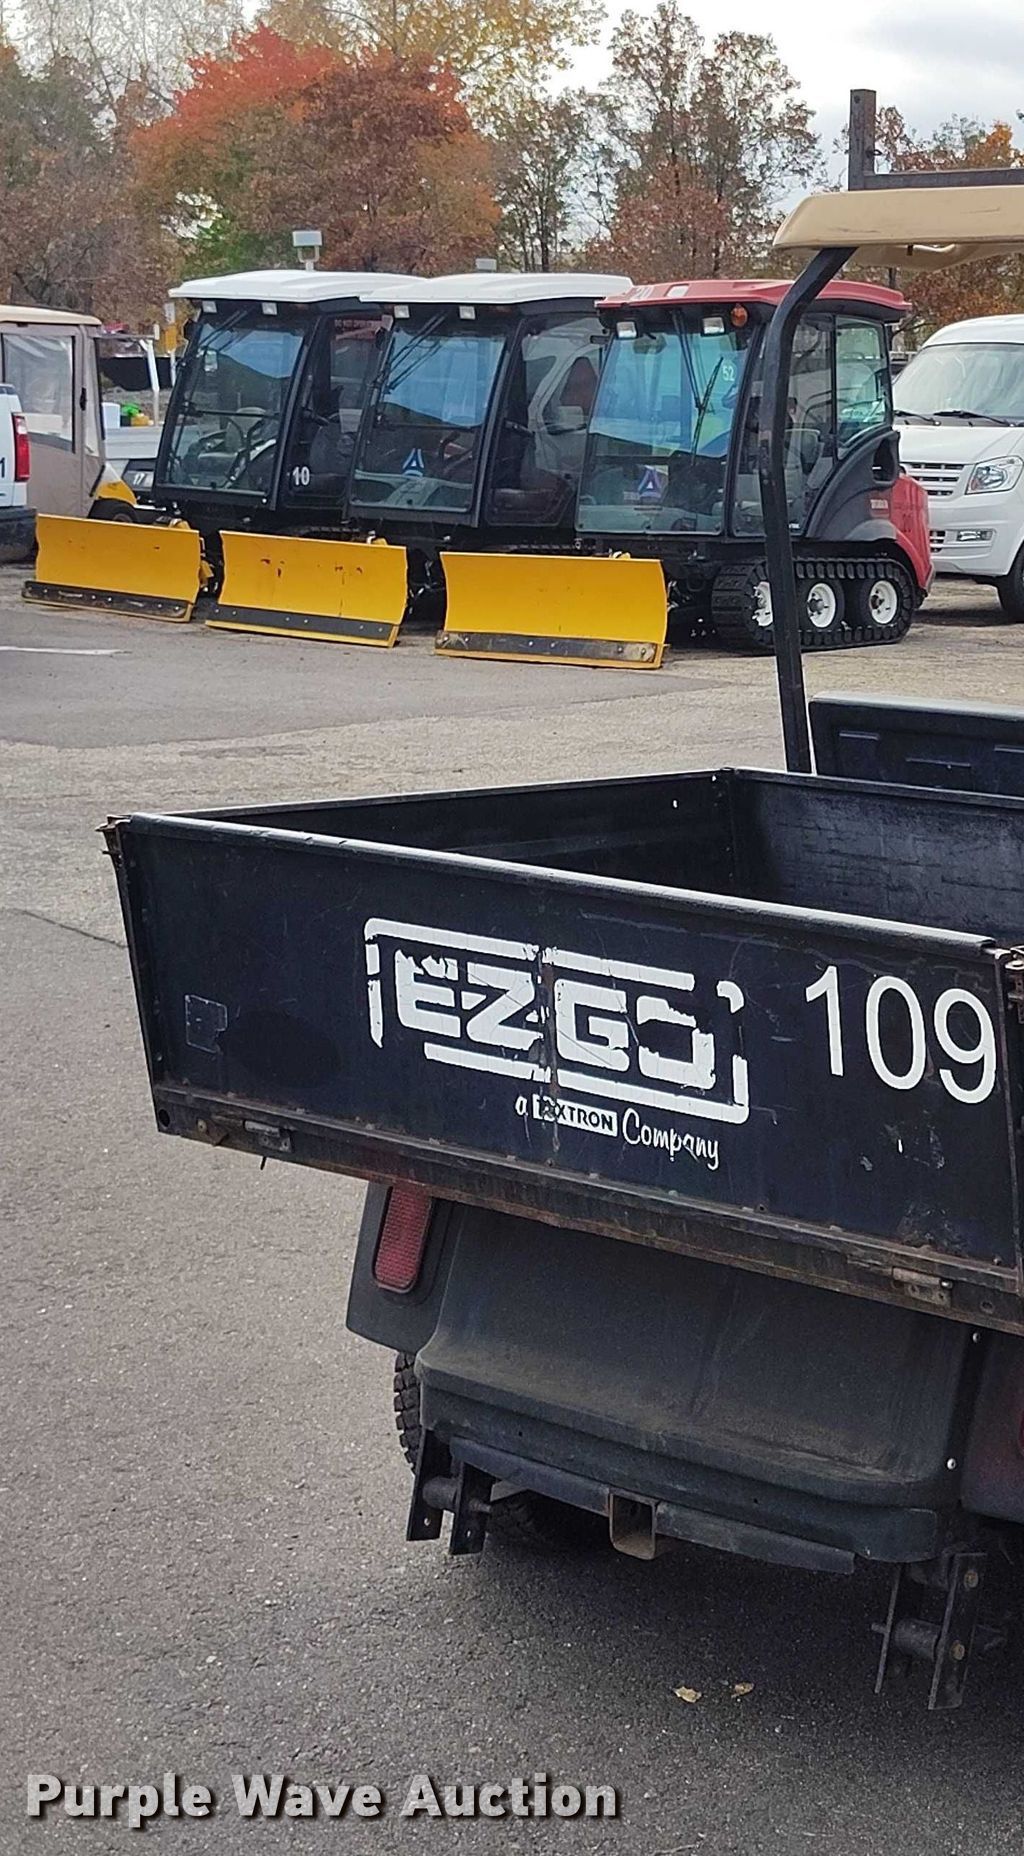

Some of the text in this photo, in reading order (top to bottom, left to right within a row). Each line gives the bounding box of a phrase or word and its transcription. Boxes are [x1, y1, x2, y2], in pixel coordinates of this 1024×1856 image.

[292, 466, 310, 486] 10
[806, 965, 997, 1104] 109
[622, 1107, 719, 1171] Company
